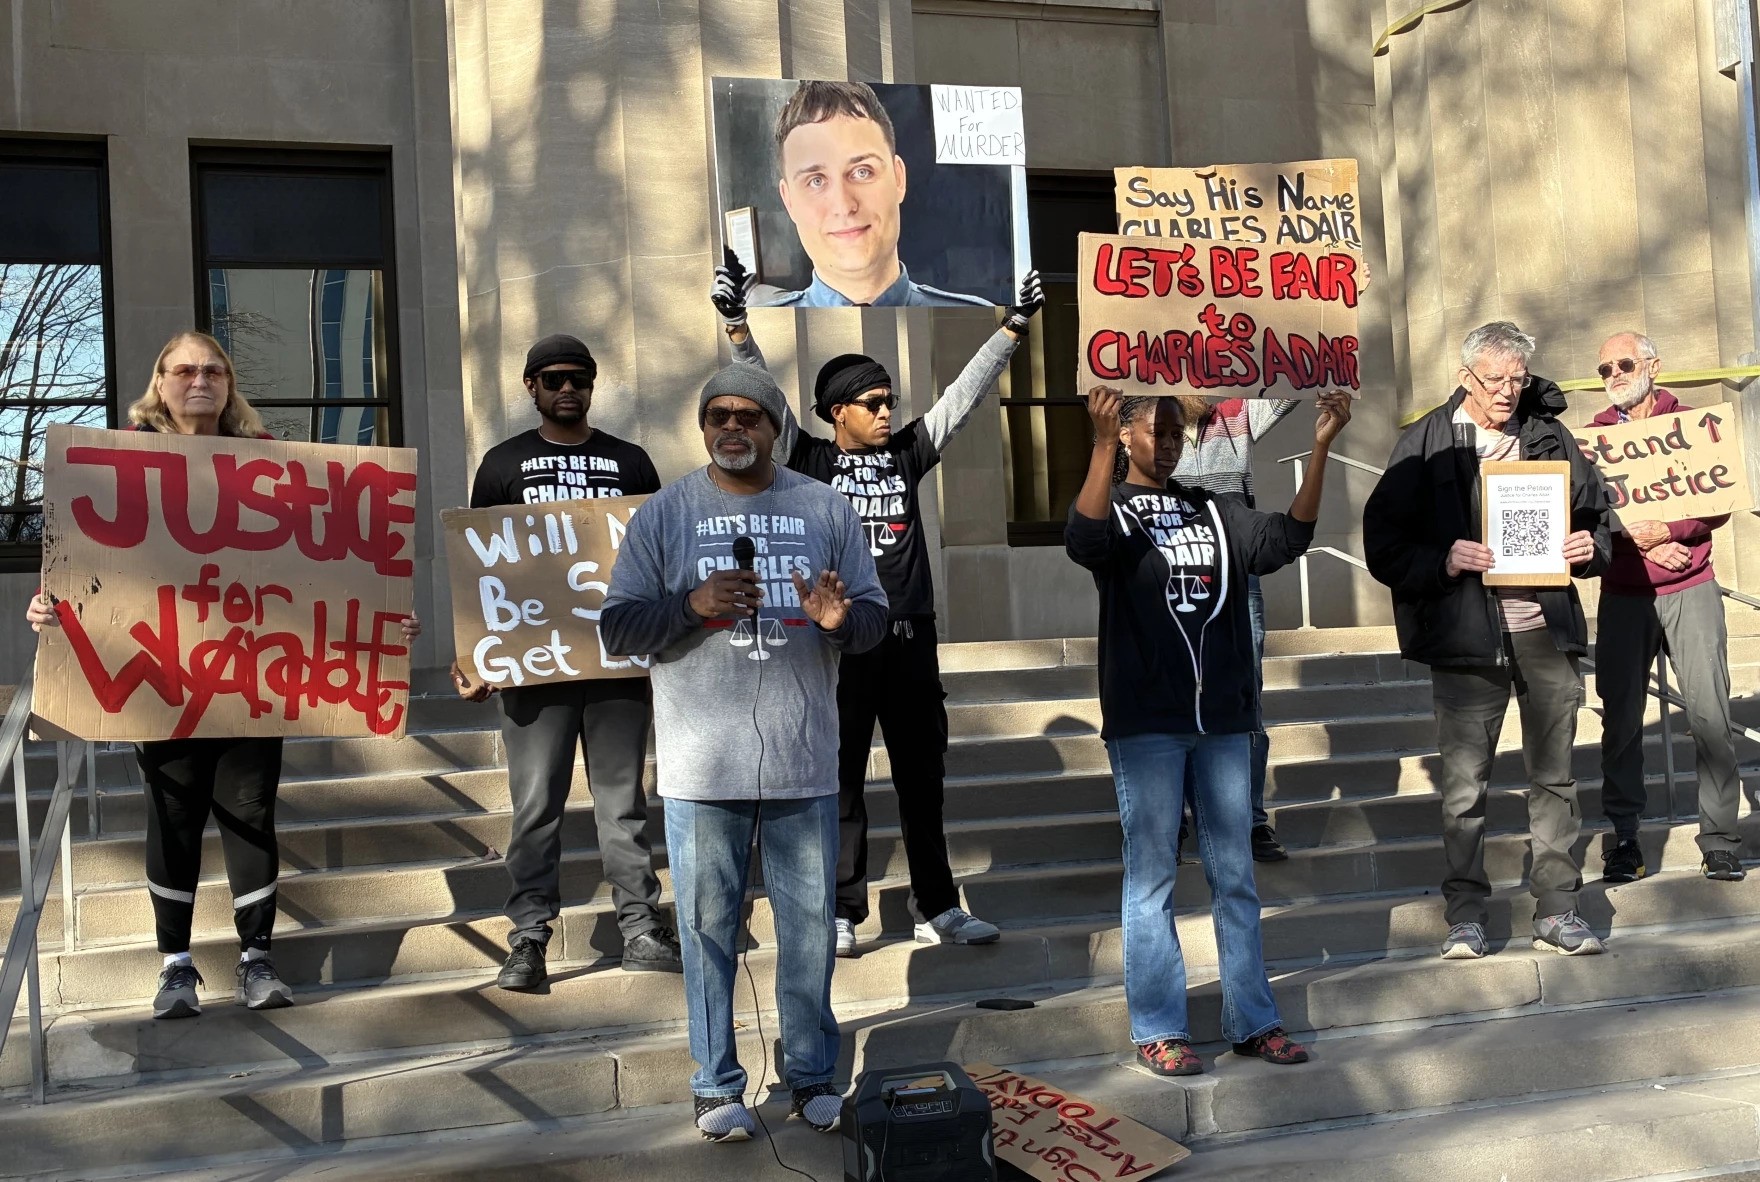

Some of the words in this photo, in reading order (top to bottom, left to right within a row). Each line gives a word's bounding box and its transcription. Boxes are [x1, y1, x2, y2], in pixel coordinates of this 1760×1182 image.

[934, 86, 1018, 113] WANTED
[960, 116, 983, 133] For
[937, 132, 1024, 160] MURDER
[1126, 176, 1195, 217] Say
[1122, 216, 1267, 243] CHARLES
[1277, 211, 1360, 245] ADAIR
[1209, 245, 1263, 299] BE
[1269, 251, 1358, 309] FAIR
[1197, 303, 1257, 339] to
[1087, 329, 1261, 389] CHARLES
[1263, 327, 1360, 391] ADAIR
[520, 455, 567, 473] #LET'S
[569, 455, 588, 470] BE
[589, 456, 620, 473] FAIR
[854, 466, 879, 482] FOR
[557, 471, 587, 486] FOR
[1497, 485, 1513, 493] Sign
[1527, 484, 1553, 492] Petition
[1603, 464, 1736, 510] Justice
[849, 494, 906, 518] DAIR
[1161, 495, 1181, 512] BE
[695, 514, 747, 537] #LET'S
[750, 514, 769, 534] BE
[771, 515, 806, 536] FAIR
[1152, 513, 1183, 527] FOR
[465, 511, 578, 568] Will
[697, 555, 811, 581] CHRLES
[1158, 543, 1215, 567] DAIR
[181, 563, 293, 626] for
[479, 575, 550, 632] Be
[754, 582, 801, 608] AIR
[473, 629, 582, 686] Get
[1044, 1117, 1155, 1178] Arrest
